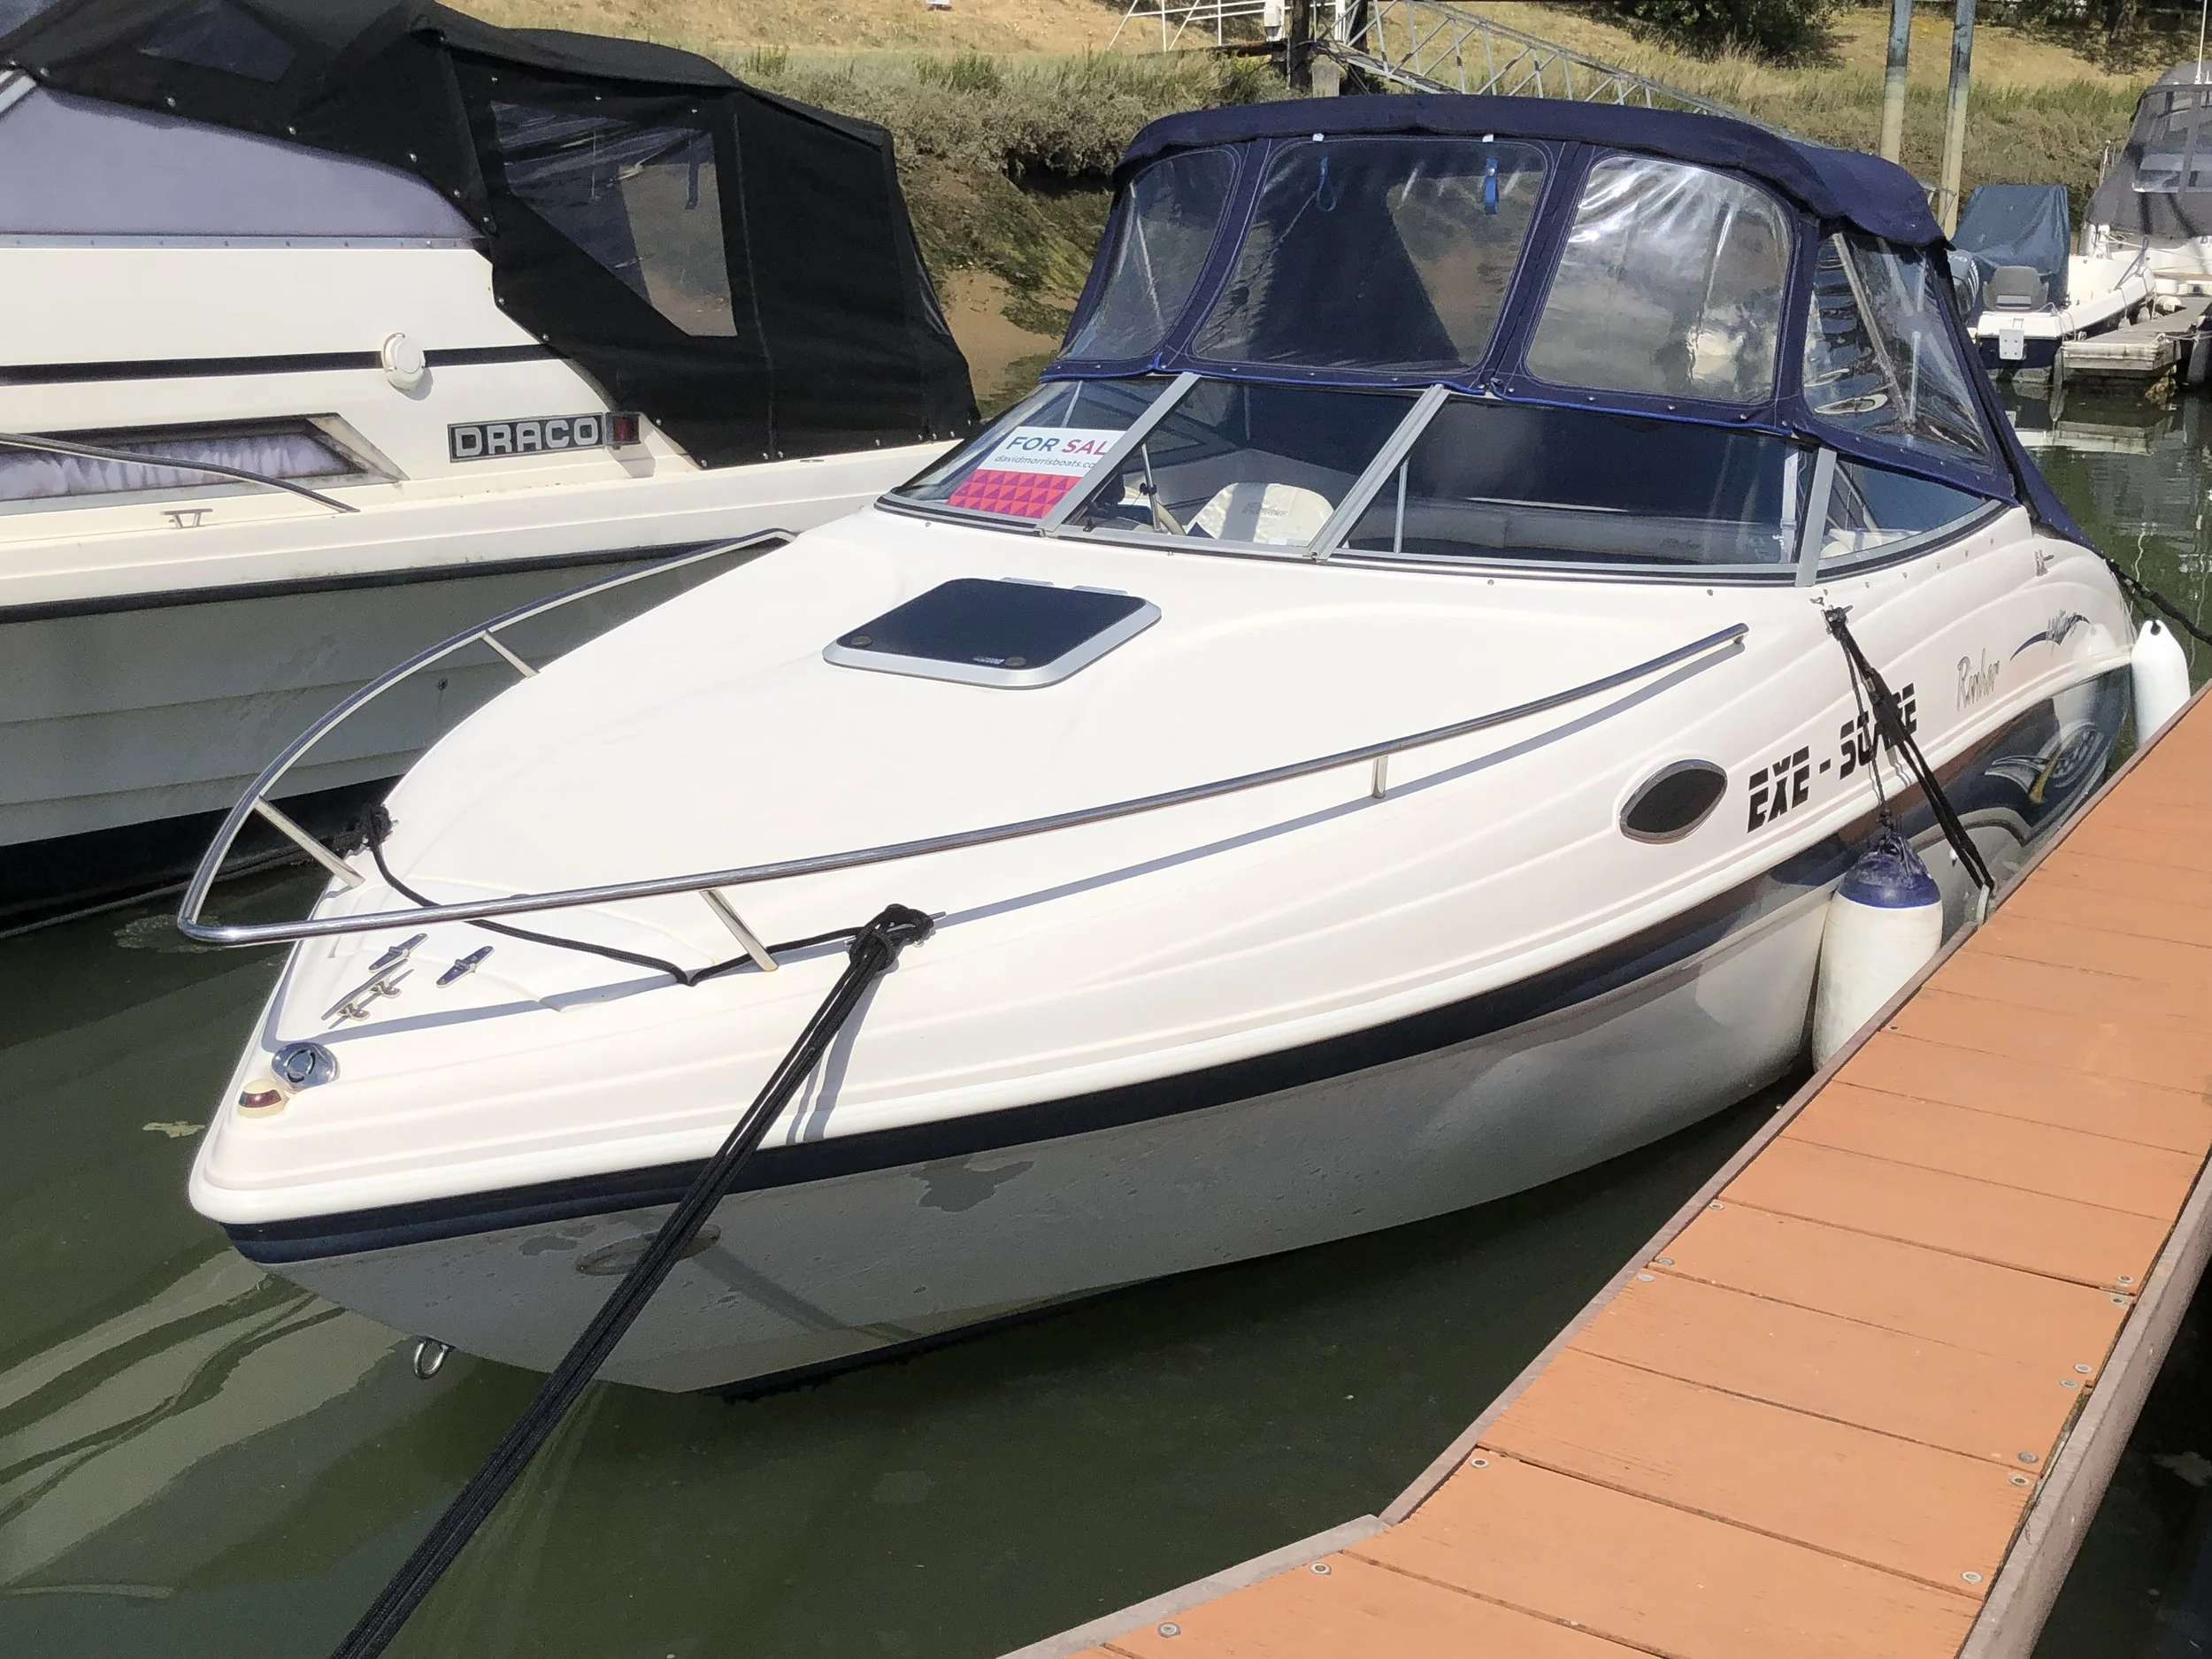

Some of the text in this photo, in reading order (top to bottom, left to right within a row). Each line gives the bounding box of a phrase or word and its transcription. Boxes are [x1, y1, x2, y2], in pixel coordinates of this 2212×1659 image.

[455, 417, 599, 457] DRACO
[1005, 436, 1108, 456] FOR SAL
[995, 454, 1096, 469] davidmorrisboats.co
[1747, 744, 1810, 833] EXE
